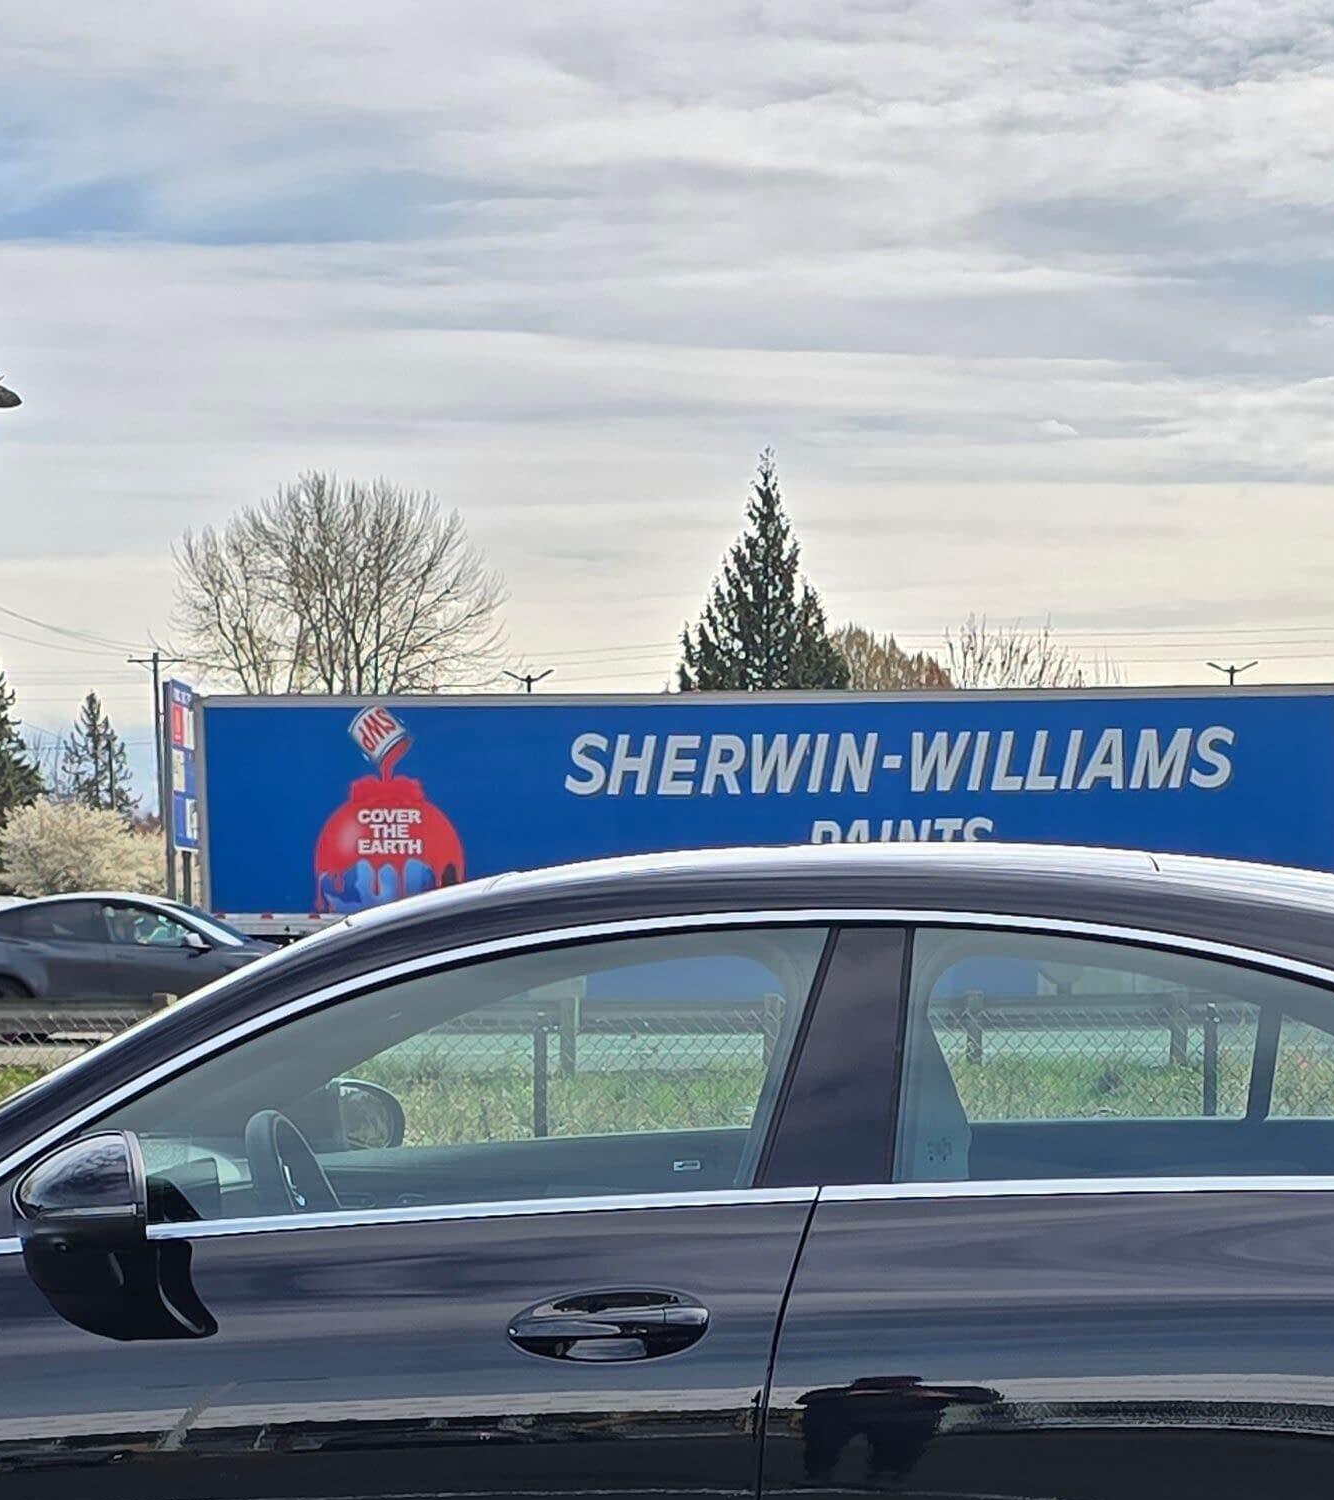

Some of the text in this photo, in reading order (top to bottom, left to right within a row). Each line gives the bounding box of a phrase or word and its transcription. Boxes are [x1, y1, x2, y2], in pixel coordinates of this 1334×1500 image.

[357, 708, 397, 752] SWP
[564, 725, 1236, 796] SHERWIN-WILLIAMS
[356, 808, 423, 824] COVER
[368, 823, 410, 839] THE
[357, 838, 423, 856] EARTH
